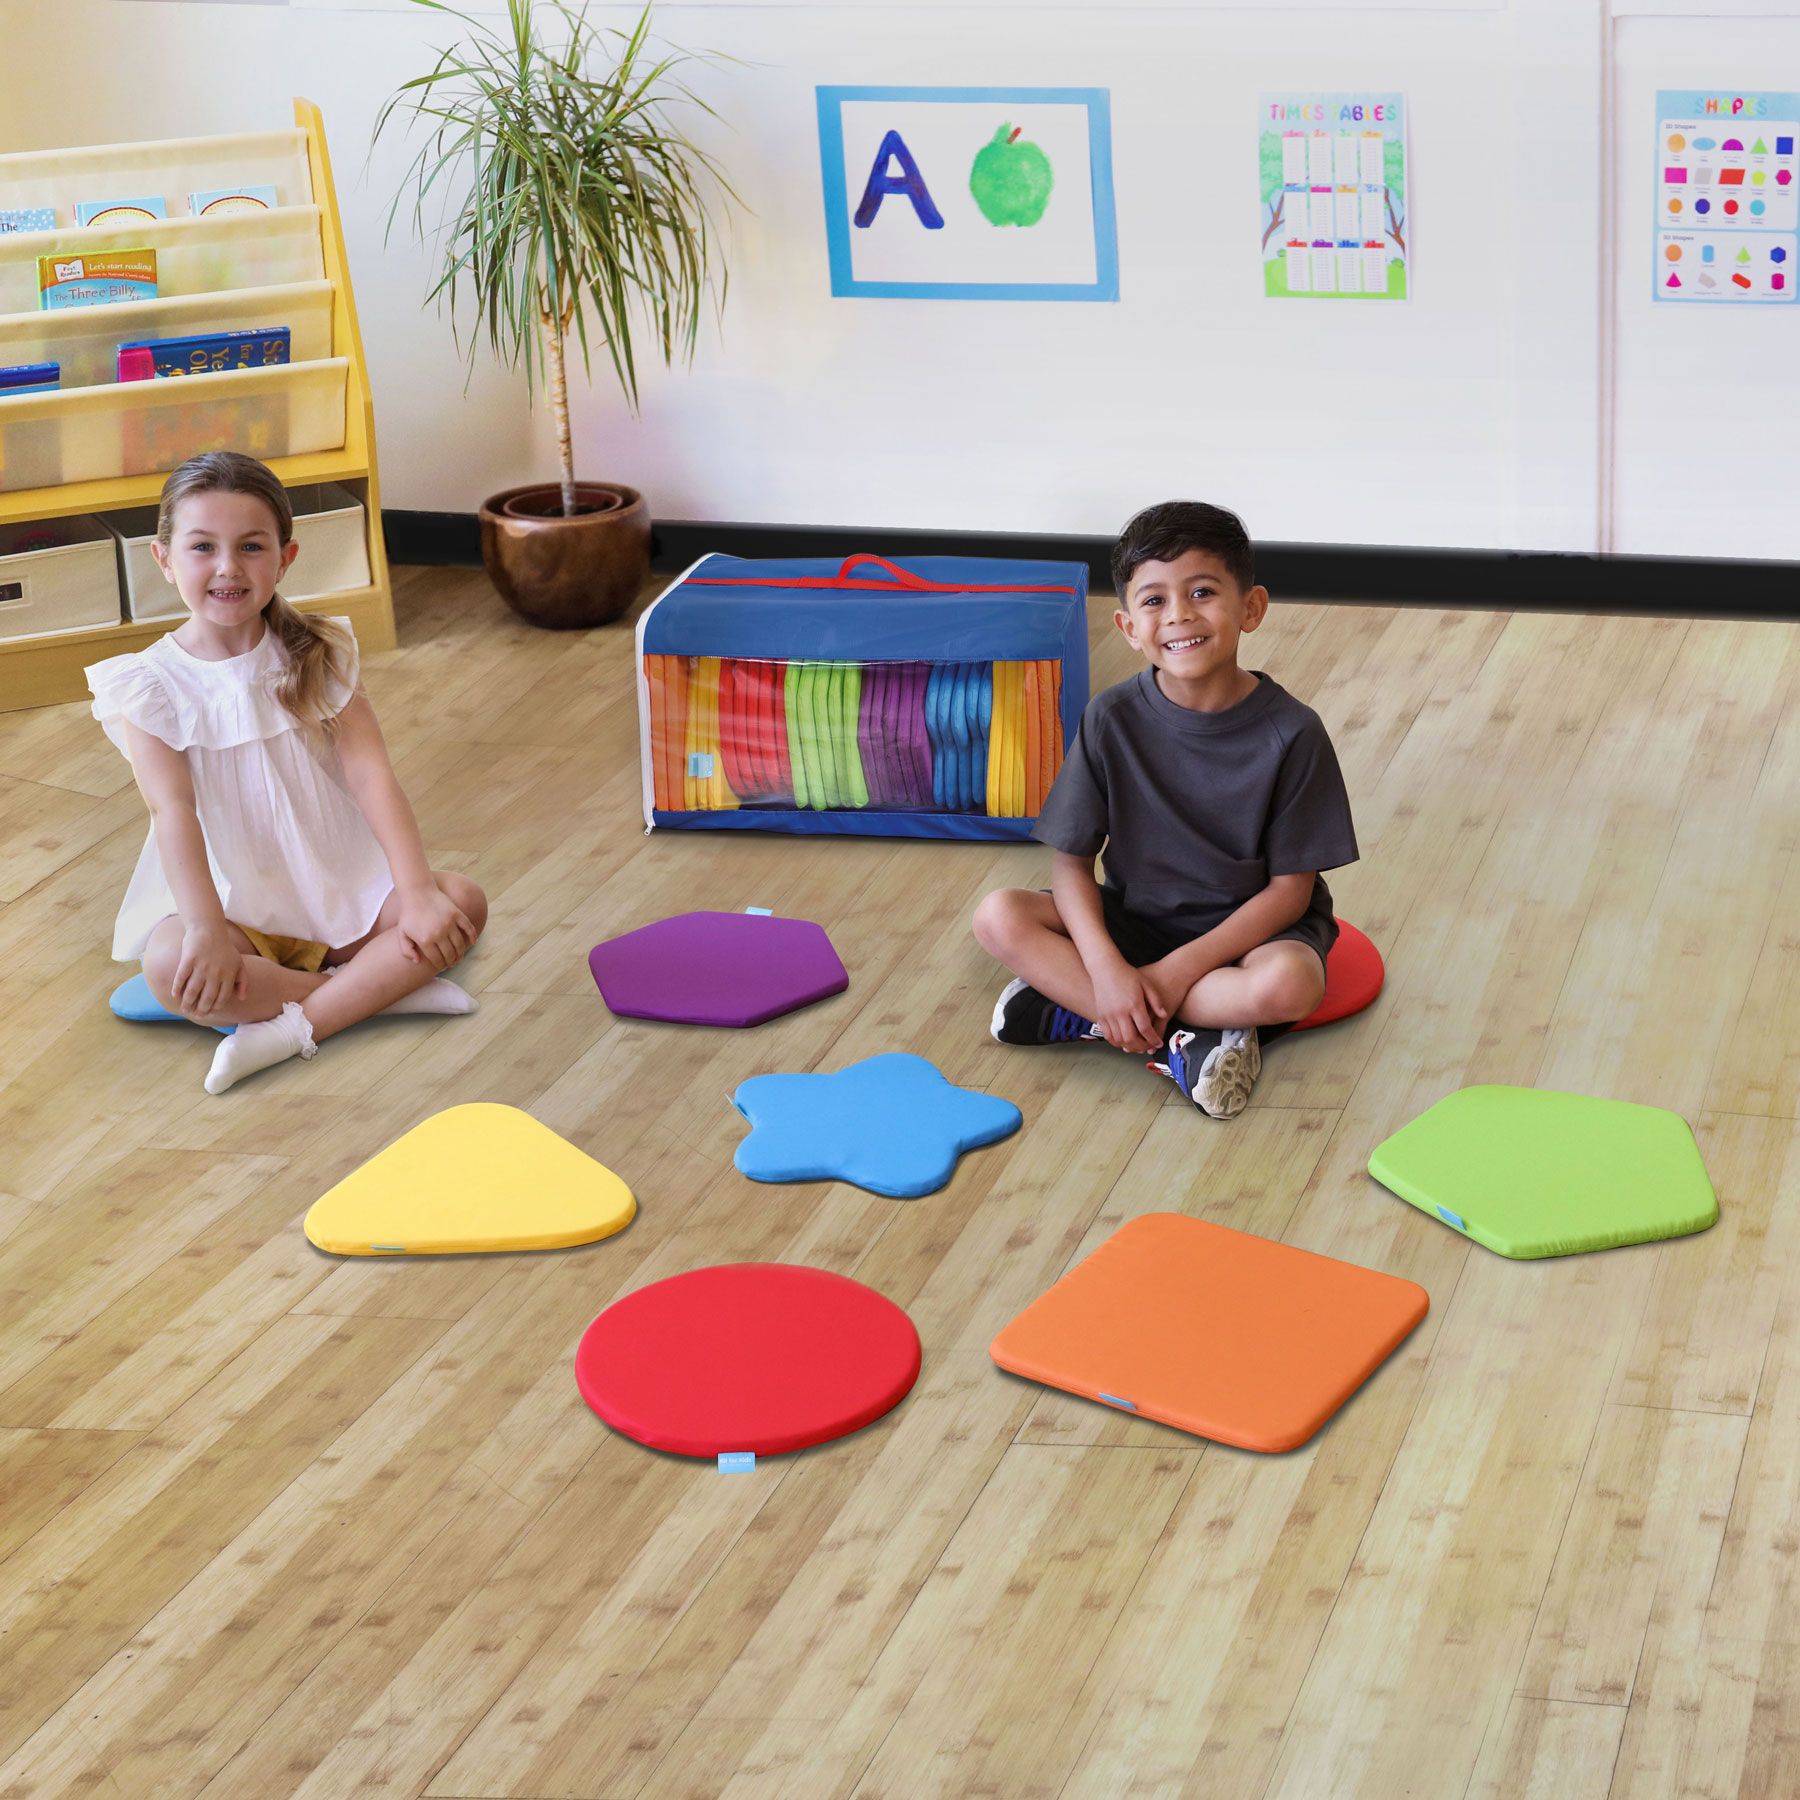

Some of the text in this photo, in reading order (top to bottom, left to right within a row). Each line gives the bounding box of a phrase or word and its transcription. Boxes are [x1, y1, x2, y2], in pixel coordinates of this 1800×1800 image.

[1269, 104, 1397, 121] TIMES TABLES
[1694, 97, 1768, 115] SHAPES
[854, 129, 945, 229] A
[0, 222, 18, 232] The
[125, 262, 152, 271] reading
[68, 287, 106, 300] Three
[109, 284, 136, 296] Billy
[240, 344, 254, 361] for
